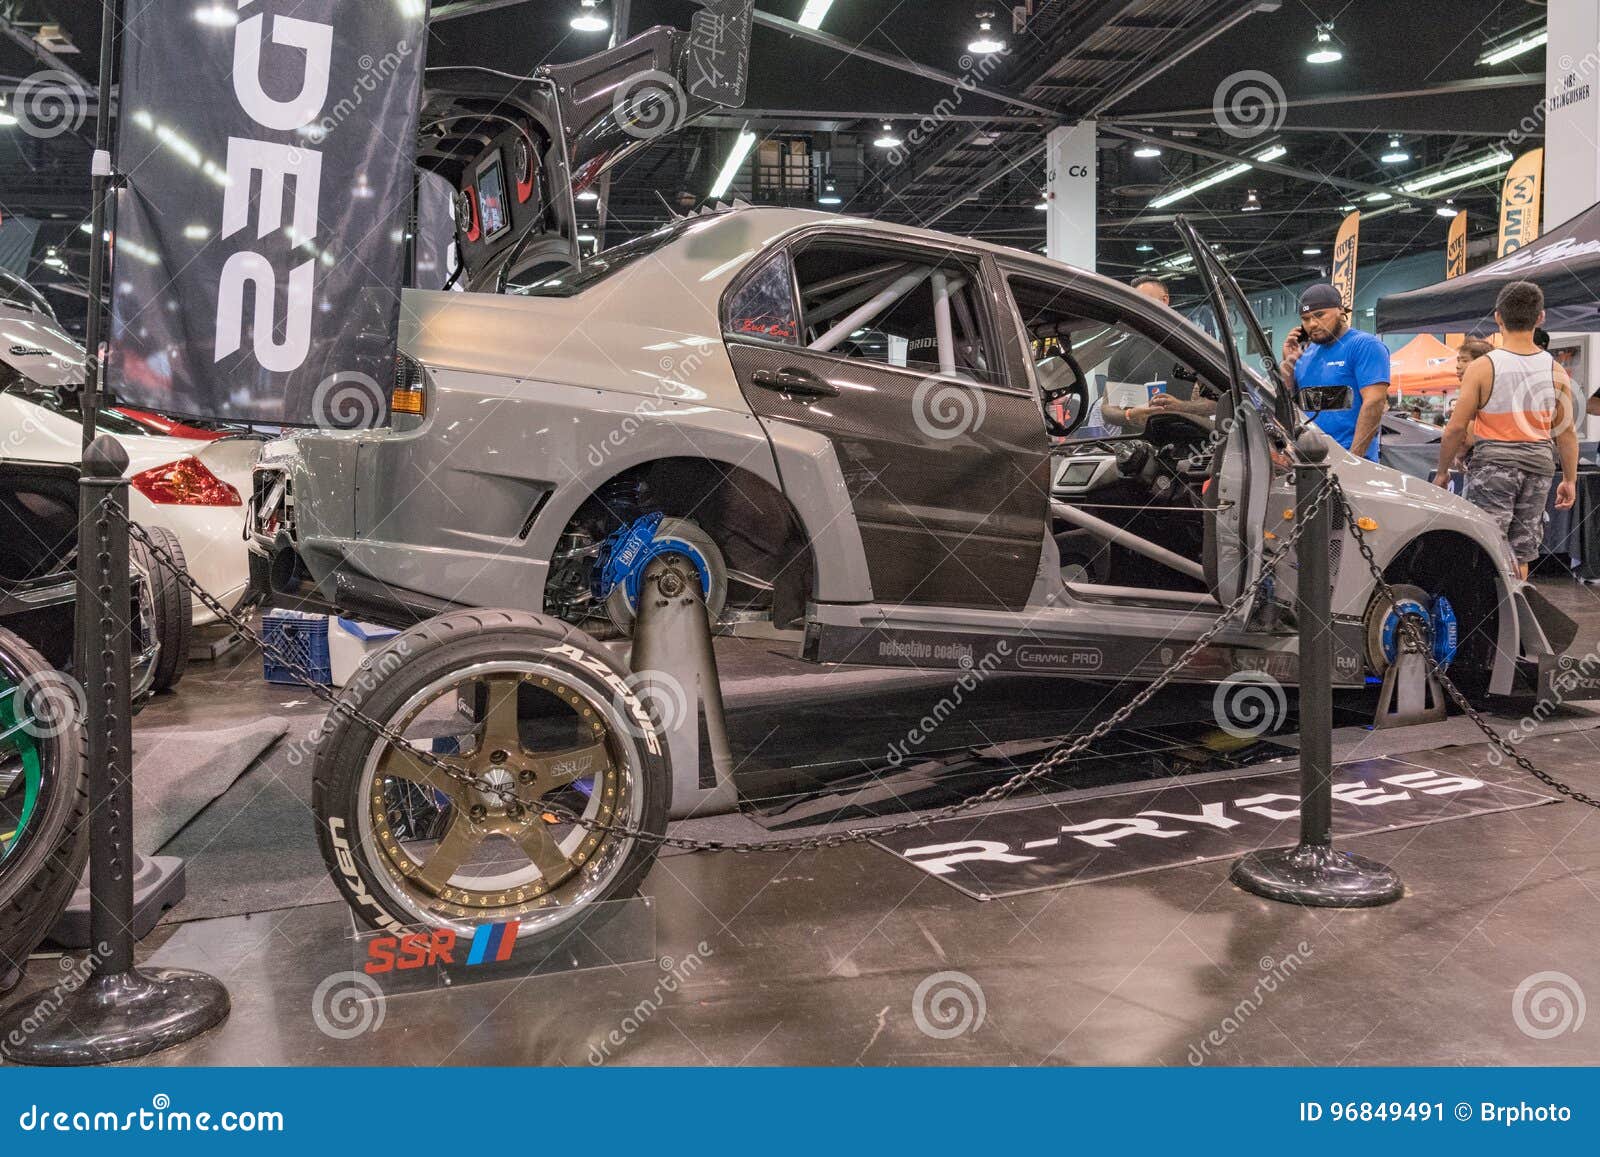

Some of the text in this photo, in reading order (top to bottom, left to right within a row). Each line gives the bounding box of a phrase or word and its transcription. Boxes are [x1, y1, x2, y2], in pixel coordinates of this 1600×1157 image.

[1068, 164, 1088, 178] C6
[1072, 652, 1099, 665] PRO
[542, 643, 662, 757] AZENIS
[364, 927, 457, 975] SSR
